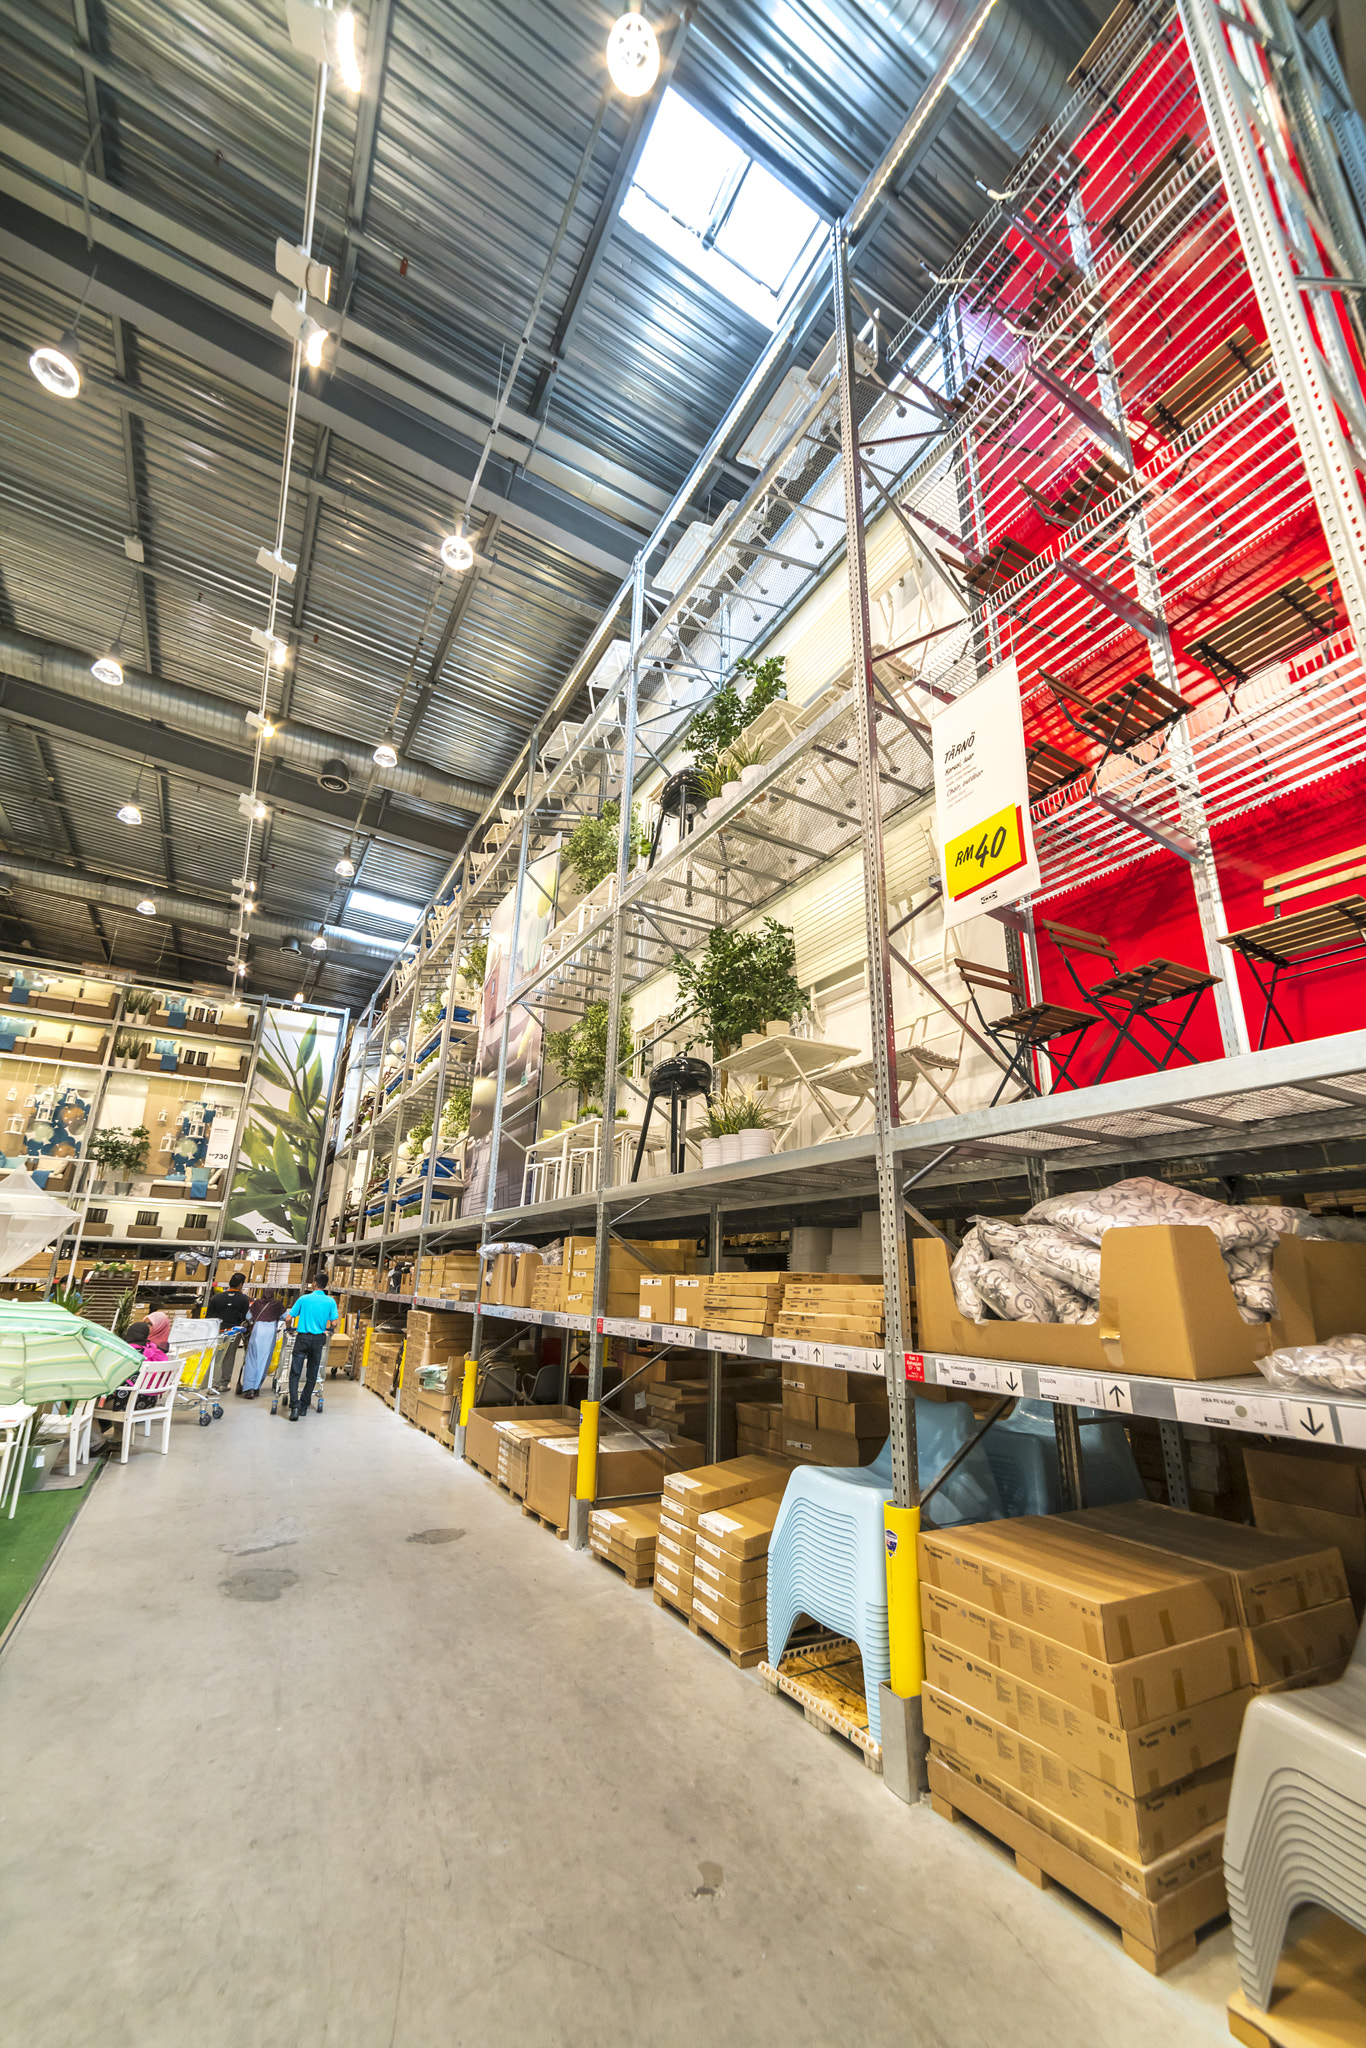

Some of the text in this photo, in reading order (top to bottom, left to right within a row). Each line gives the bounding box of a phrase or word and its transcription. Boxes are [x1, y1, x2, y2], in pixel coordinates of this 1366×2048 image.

[944, 731, 976, 764] TÄRNÖ
[946, 784, 962, 797] Chair,
[962, 770, 984, 787] outdoor
